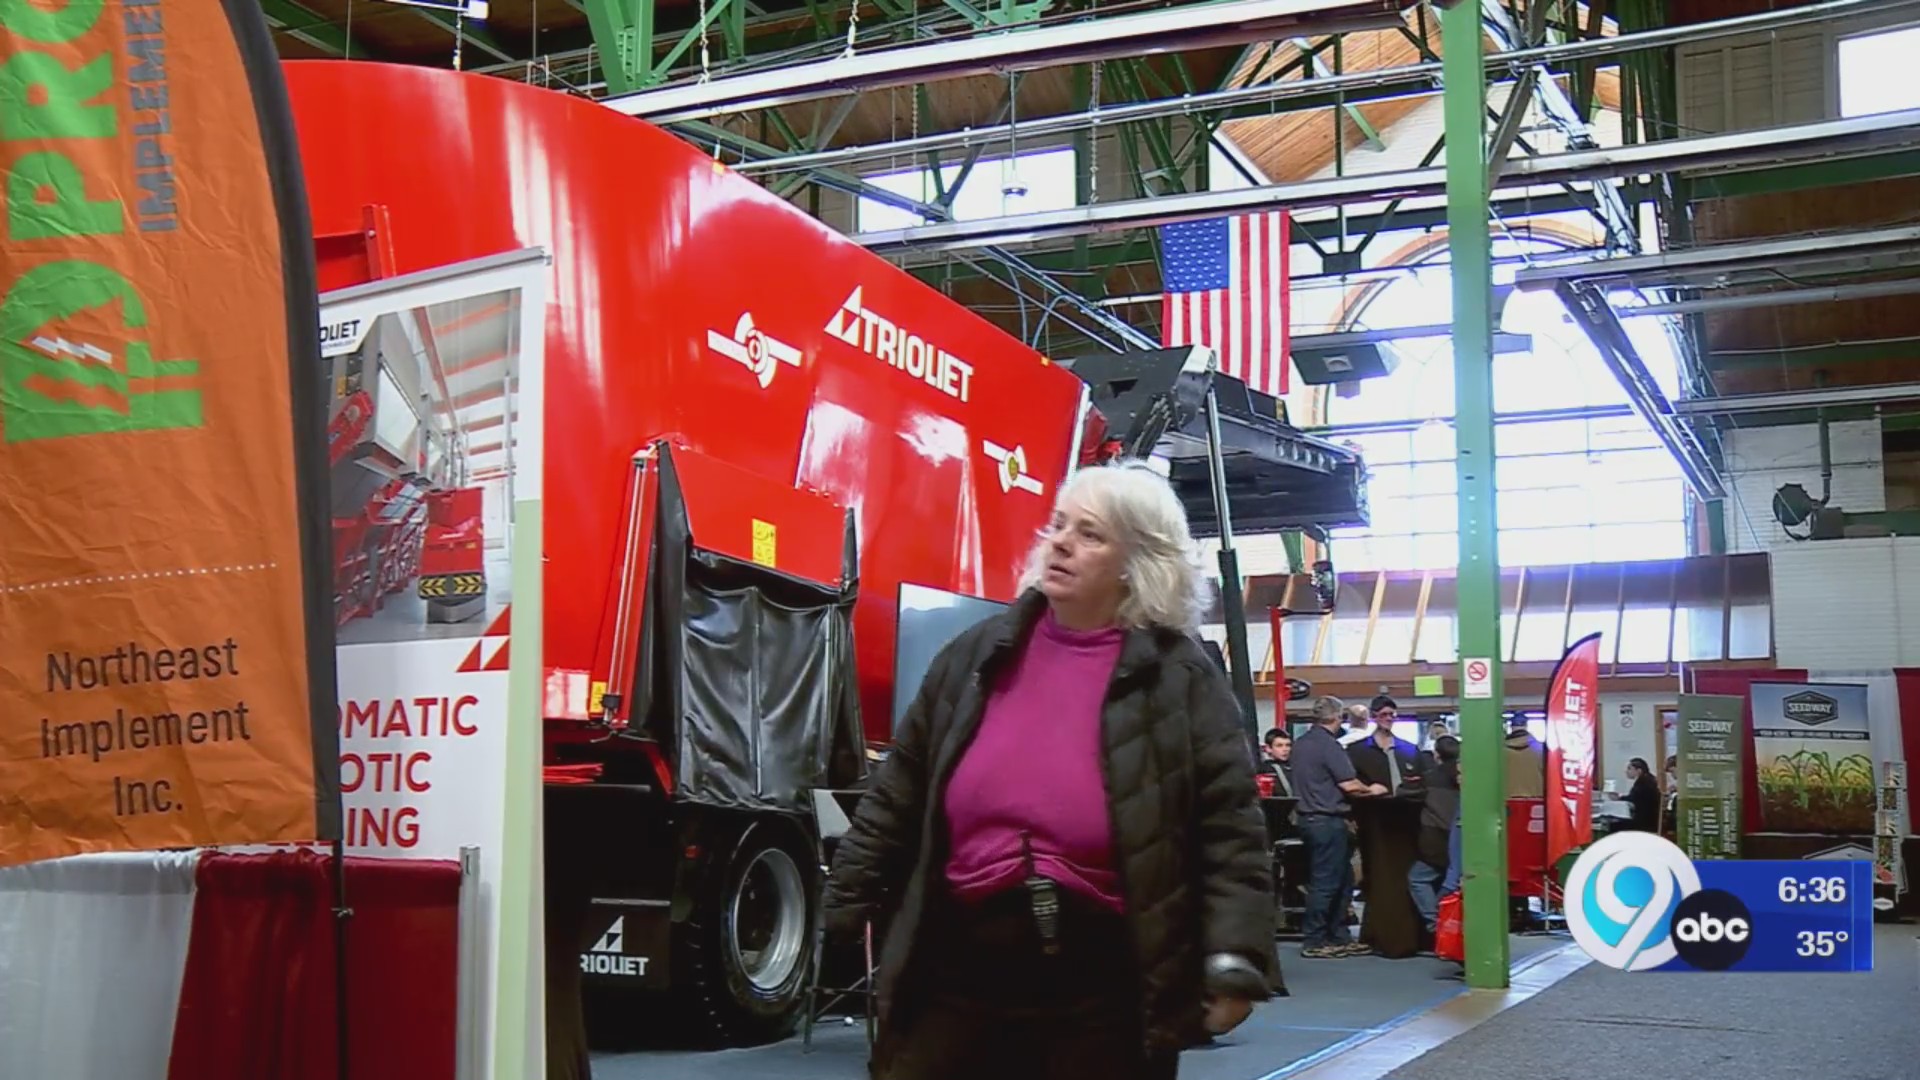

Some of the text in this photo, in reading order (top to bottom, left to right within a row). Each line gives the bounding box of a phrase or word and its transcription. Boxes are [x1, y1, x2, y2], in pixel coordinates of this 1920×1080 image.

[122, 0, 178, 232] IMPLEME
[860, 307, 975, 403] TRIOLIET
[46, 637, 239, 693] Northeast
[338, 694, 480, 739] MATIC
[1687, 720, 1734, 734] SEEDWAY
[1787, 702, 1833, 714] SEEDWAY
[40, 701, 251, 763] Implement
[113, 775, 184, 817] Inc.
[346, 806, 421, 848] ING
